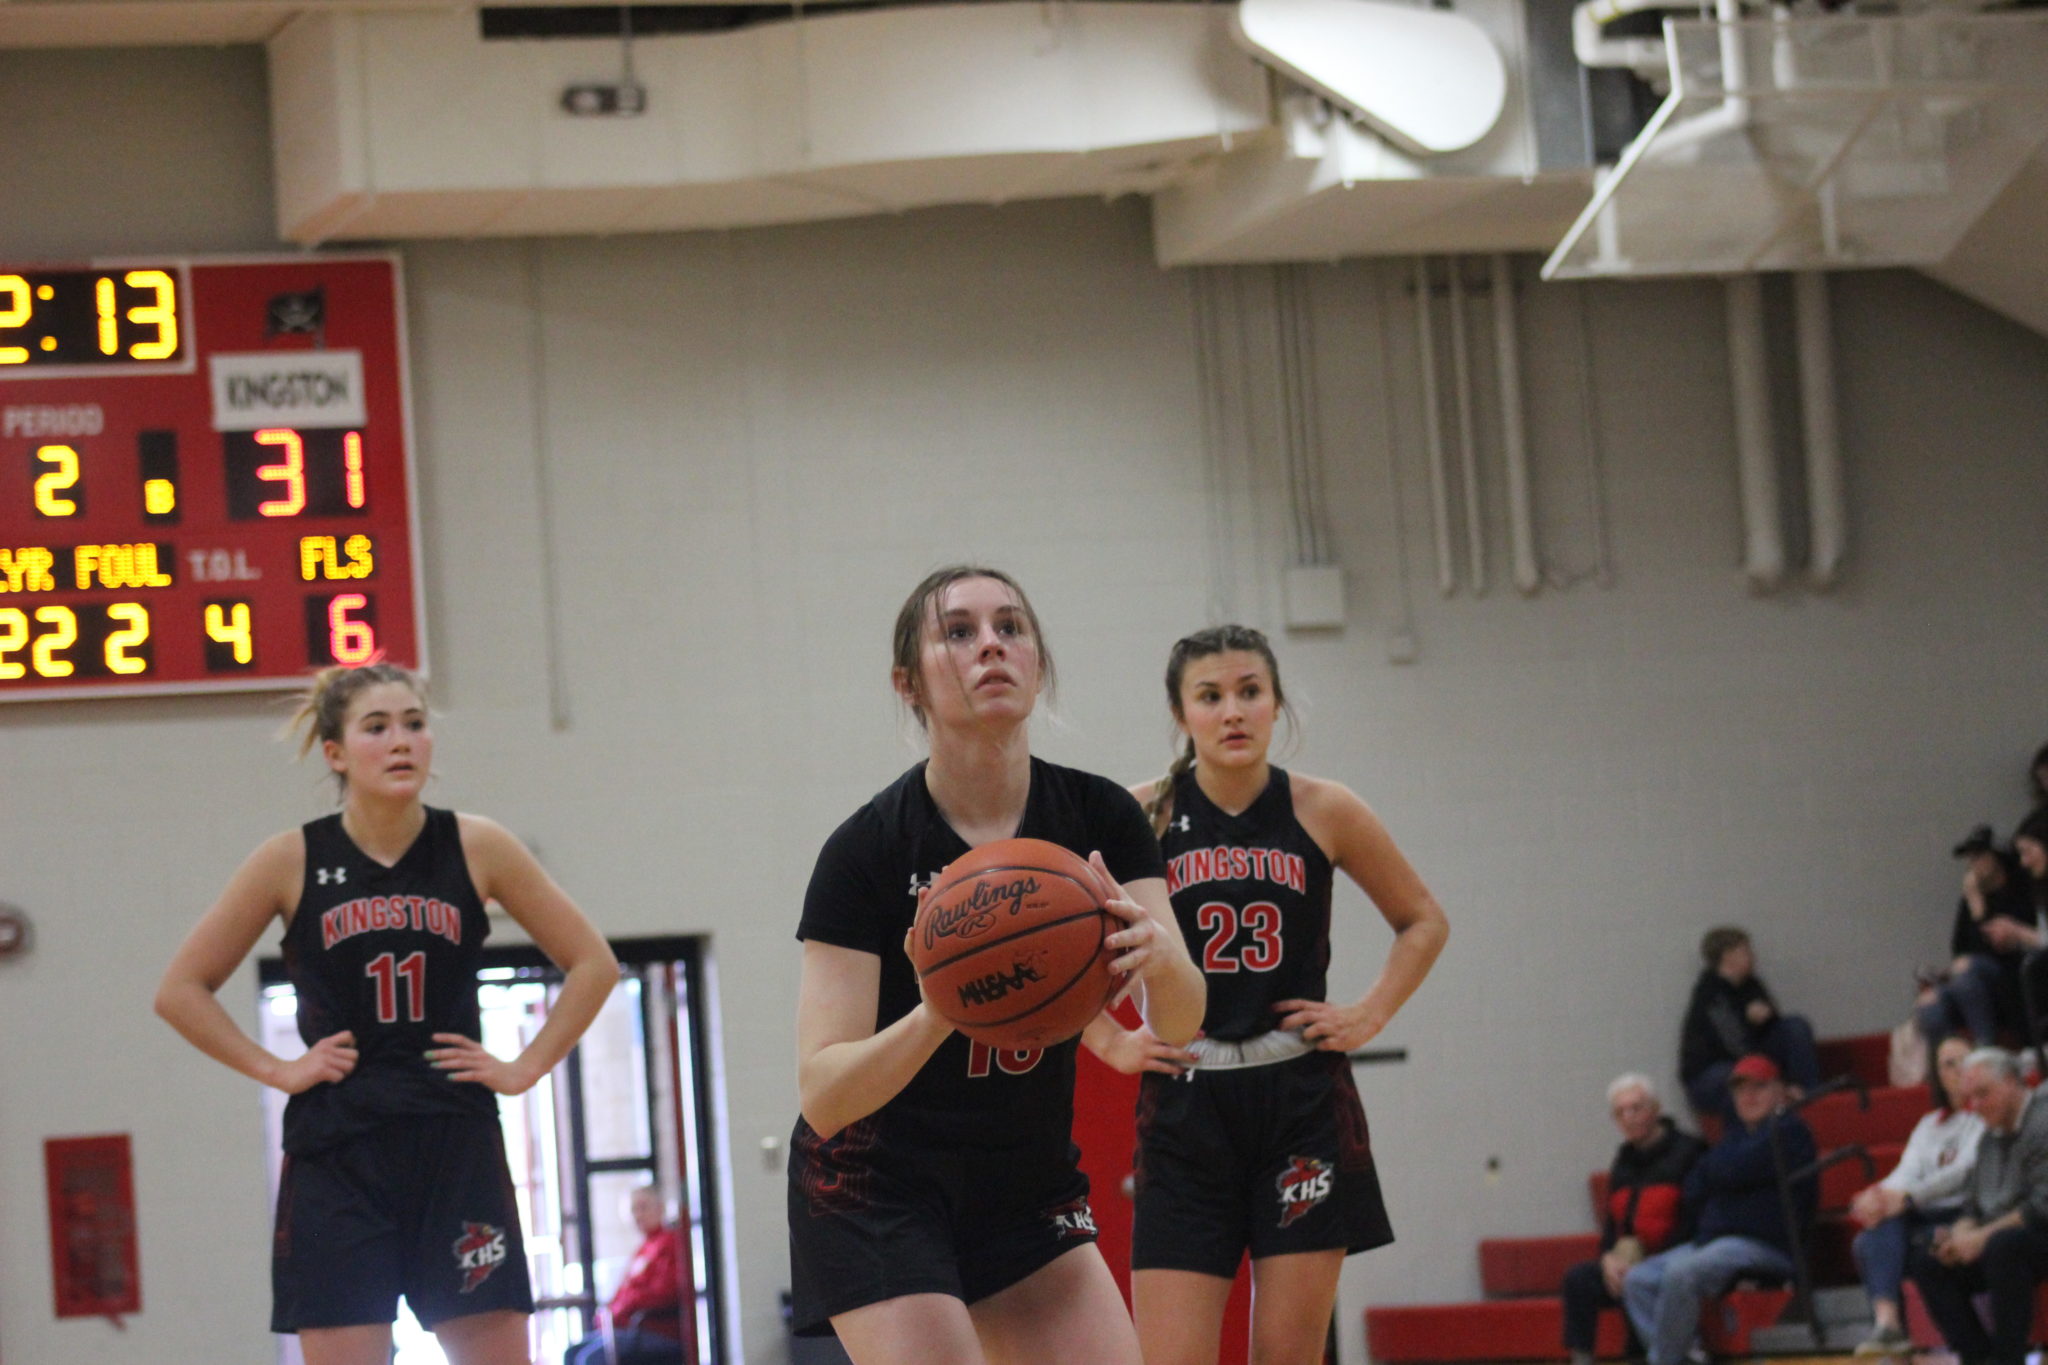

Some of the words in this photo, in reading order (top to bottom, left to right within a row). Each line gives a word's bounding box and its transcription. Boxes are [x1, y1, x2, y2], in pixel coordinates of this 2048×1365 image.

[227, 372, 349, 406] KINGSTON
[3, 406, 104, 437] PERIOD
[34, 444, 80, 517] 2
[253, 428, 366, 518] 31
[74, 543, 172, 590] FOUL
[300, 535, 373, 581] FLS
[104, 602, 149, 675] 2
[205, 602, 252, 664] 4
[328, 593, 375, 665] 6
[1166, 846, 1306, 897] KINGSTON
[321, 894, 462, 950] KINGSTON
[924, 876, 1042, 950] Rawlings
[1197, 901, 1283, 973] 23
[365, 951, 426, 1023] 11
[1281, 1168, 1332, 1203] KHS
[459, 1233, 506, 1269] KHS
